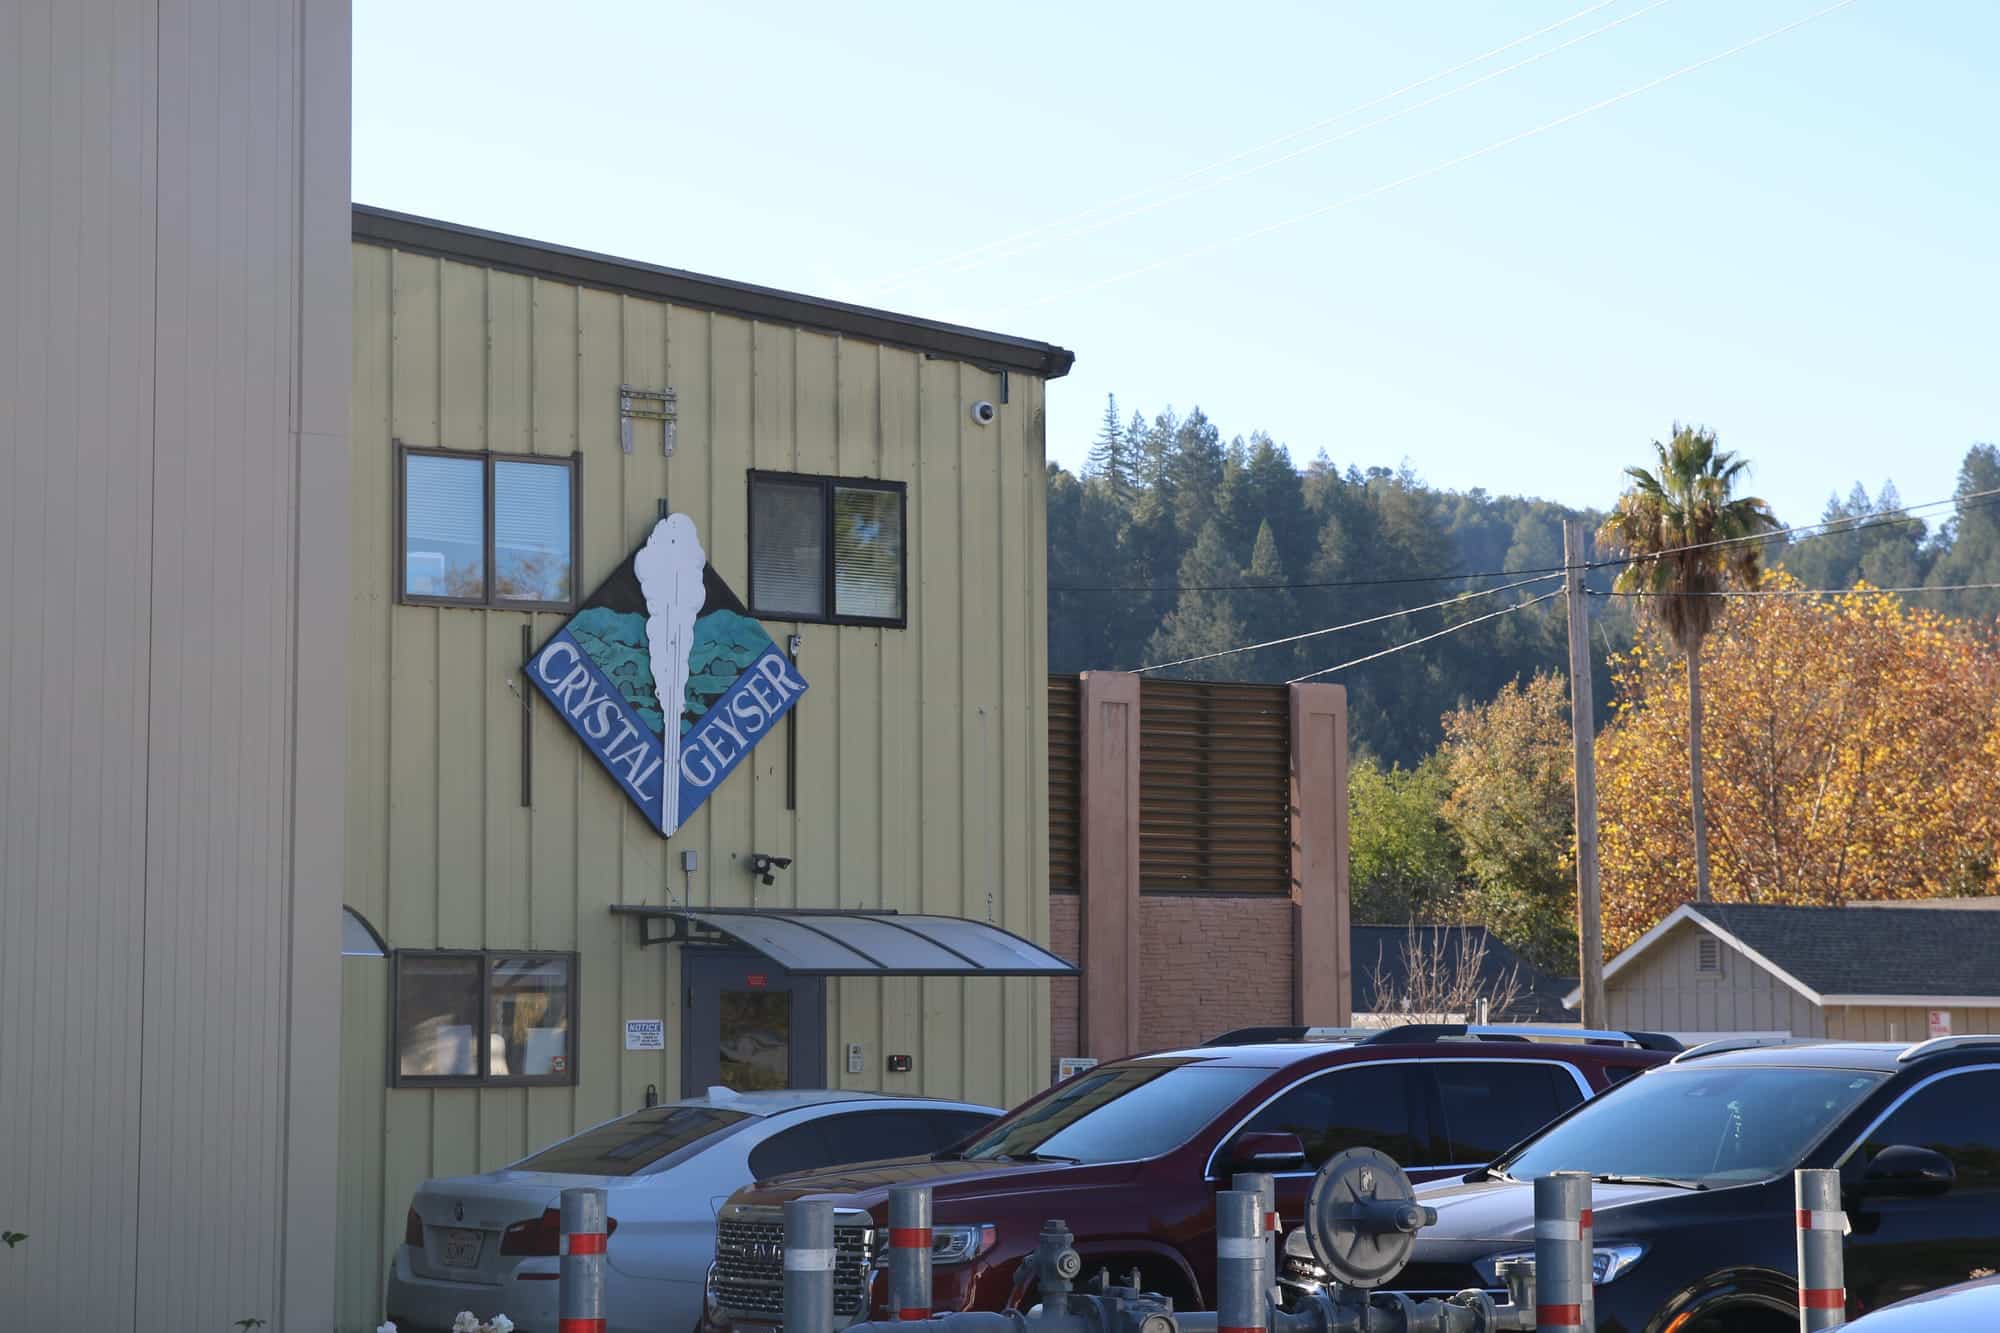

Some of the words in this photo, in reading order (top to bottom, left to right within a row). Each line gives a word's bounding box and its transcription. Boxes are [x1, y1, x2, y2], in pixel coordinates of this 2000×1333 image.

[538, 641, 663, 802] CRYSTAL
[680, 653, 806, 787] GEYSER
[629, 1023, 660, 1032] NOTICE
